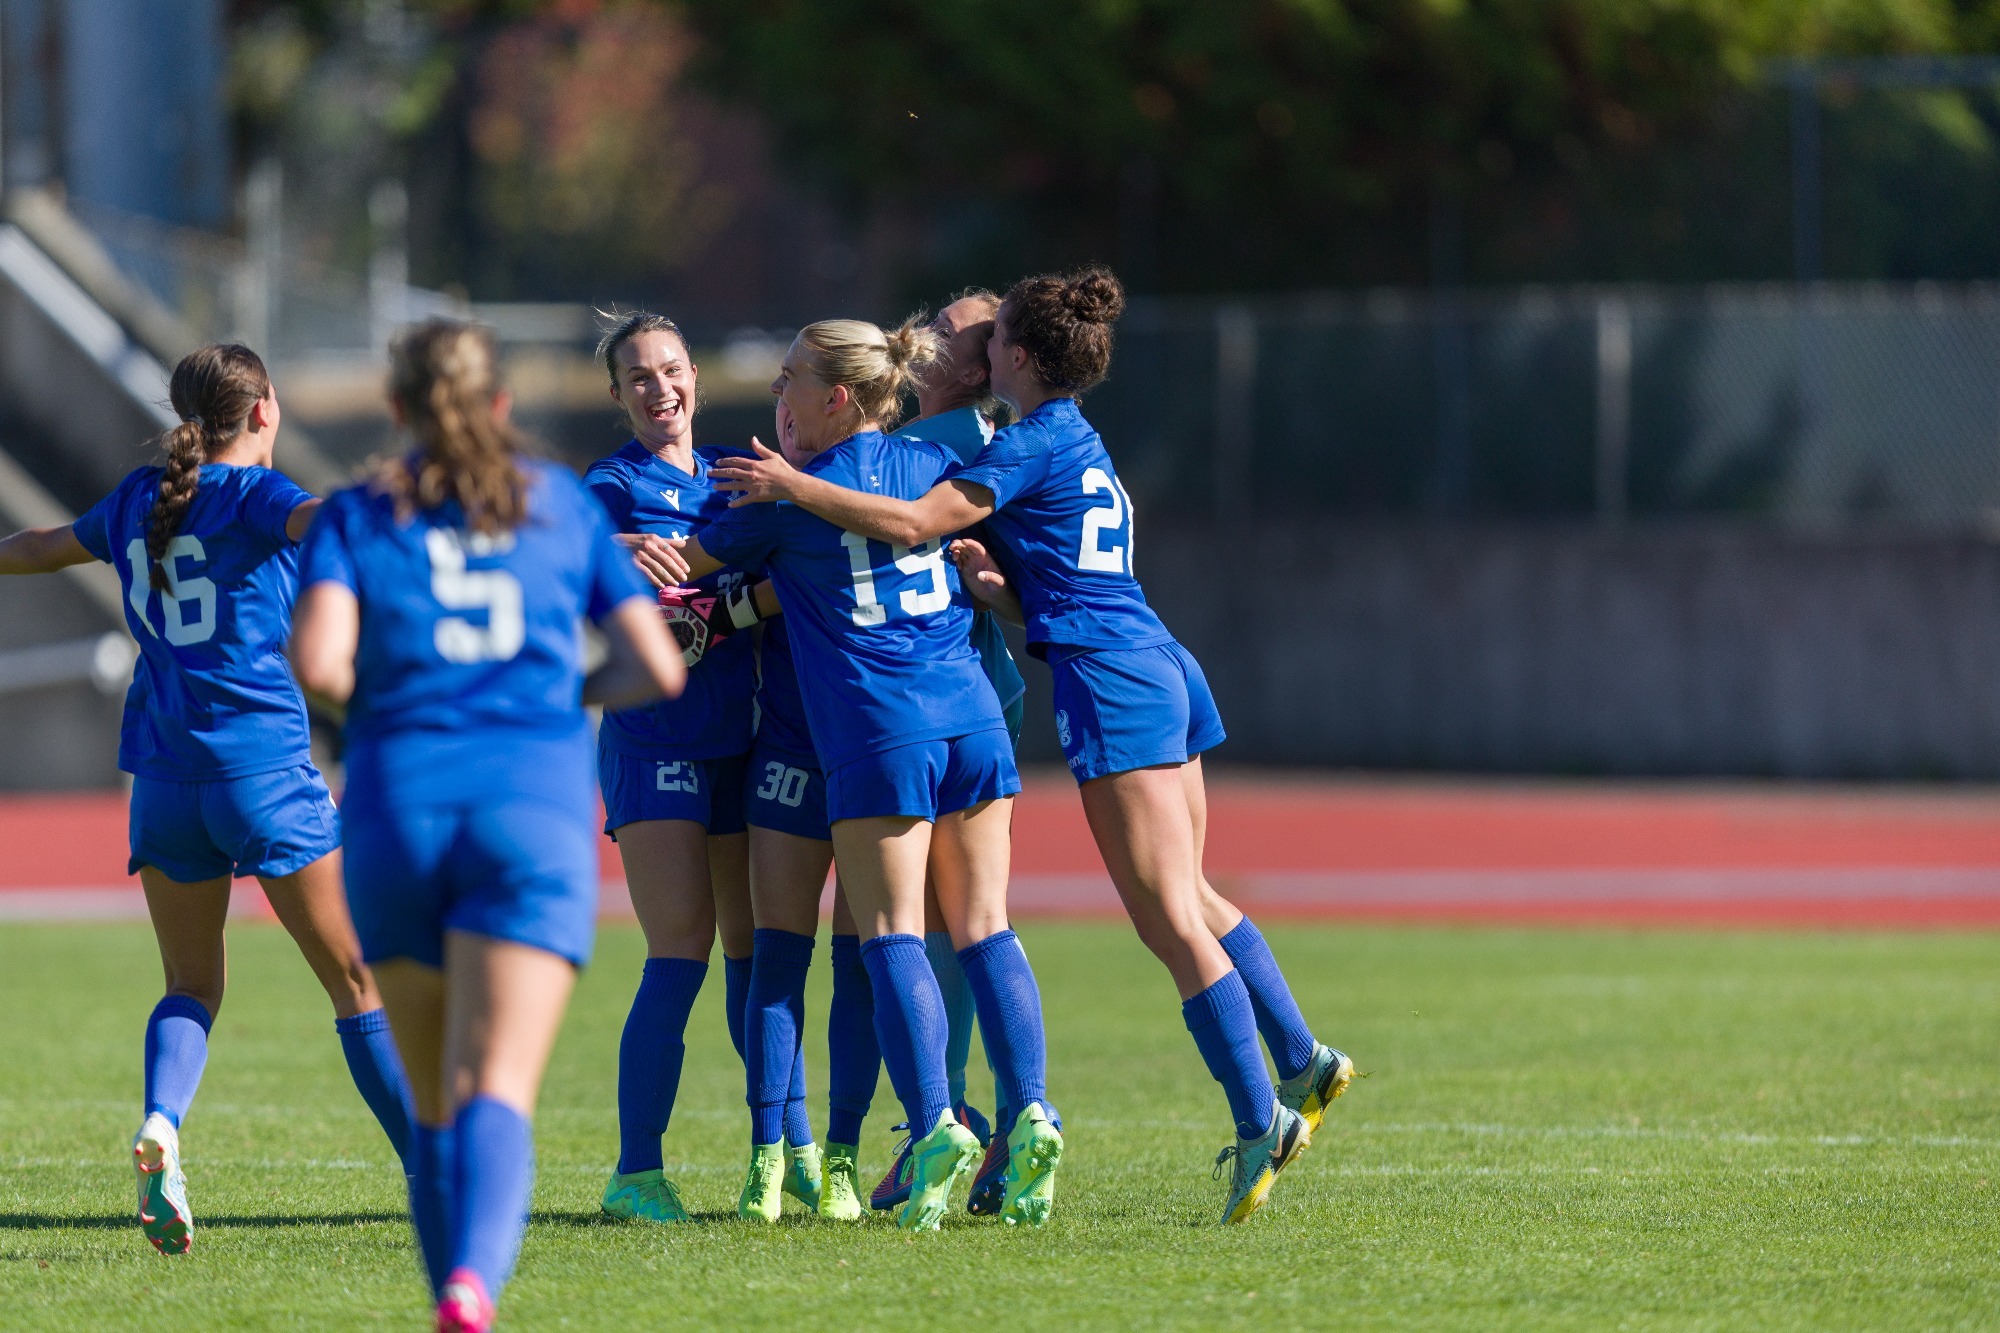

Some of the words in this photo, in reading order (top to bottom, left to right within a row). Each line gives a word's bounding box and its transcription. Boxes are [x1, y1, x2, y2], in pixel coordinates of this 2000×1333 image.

[1078, 467, 1134, 577] 2
[127, 534, 216, 646] 16
[425, 527, 525, 664] 5
[841, 531, 951, 626] 19
[657, 760, 699, 794] 23
[757, 760, 809, 807] 30
